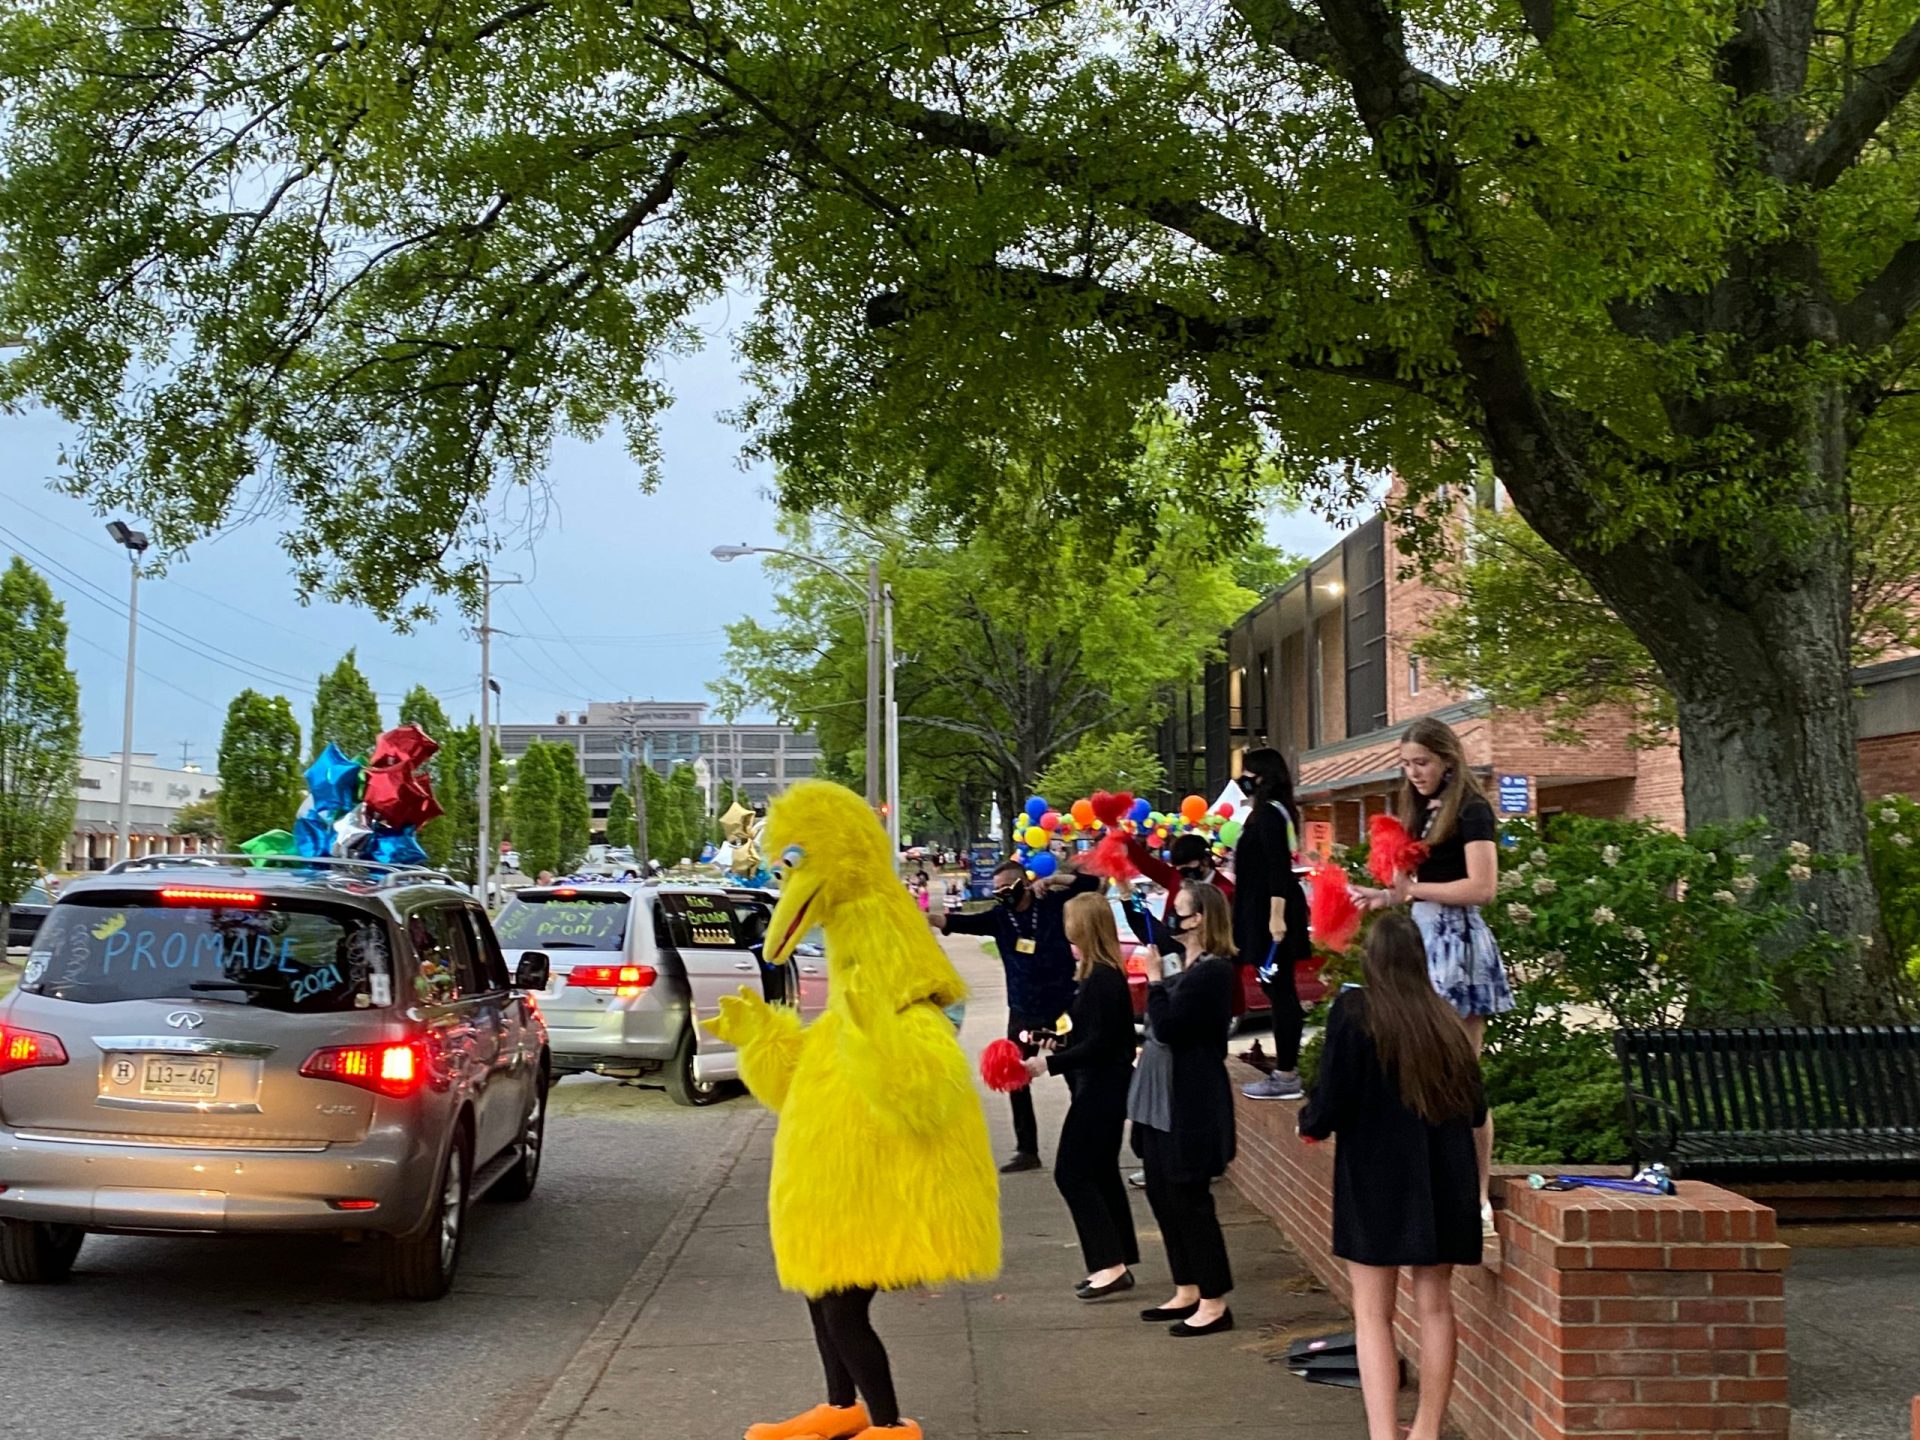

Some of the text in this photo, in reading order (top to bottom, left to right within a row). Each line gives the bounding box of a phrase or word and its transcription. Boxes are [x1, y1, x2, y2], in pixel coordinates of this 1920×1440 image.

[103, 930, 301, 975] PROMADE
[290, 963, 343, 1003] 2021
[117, 1063, 129, 1078] H
